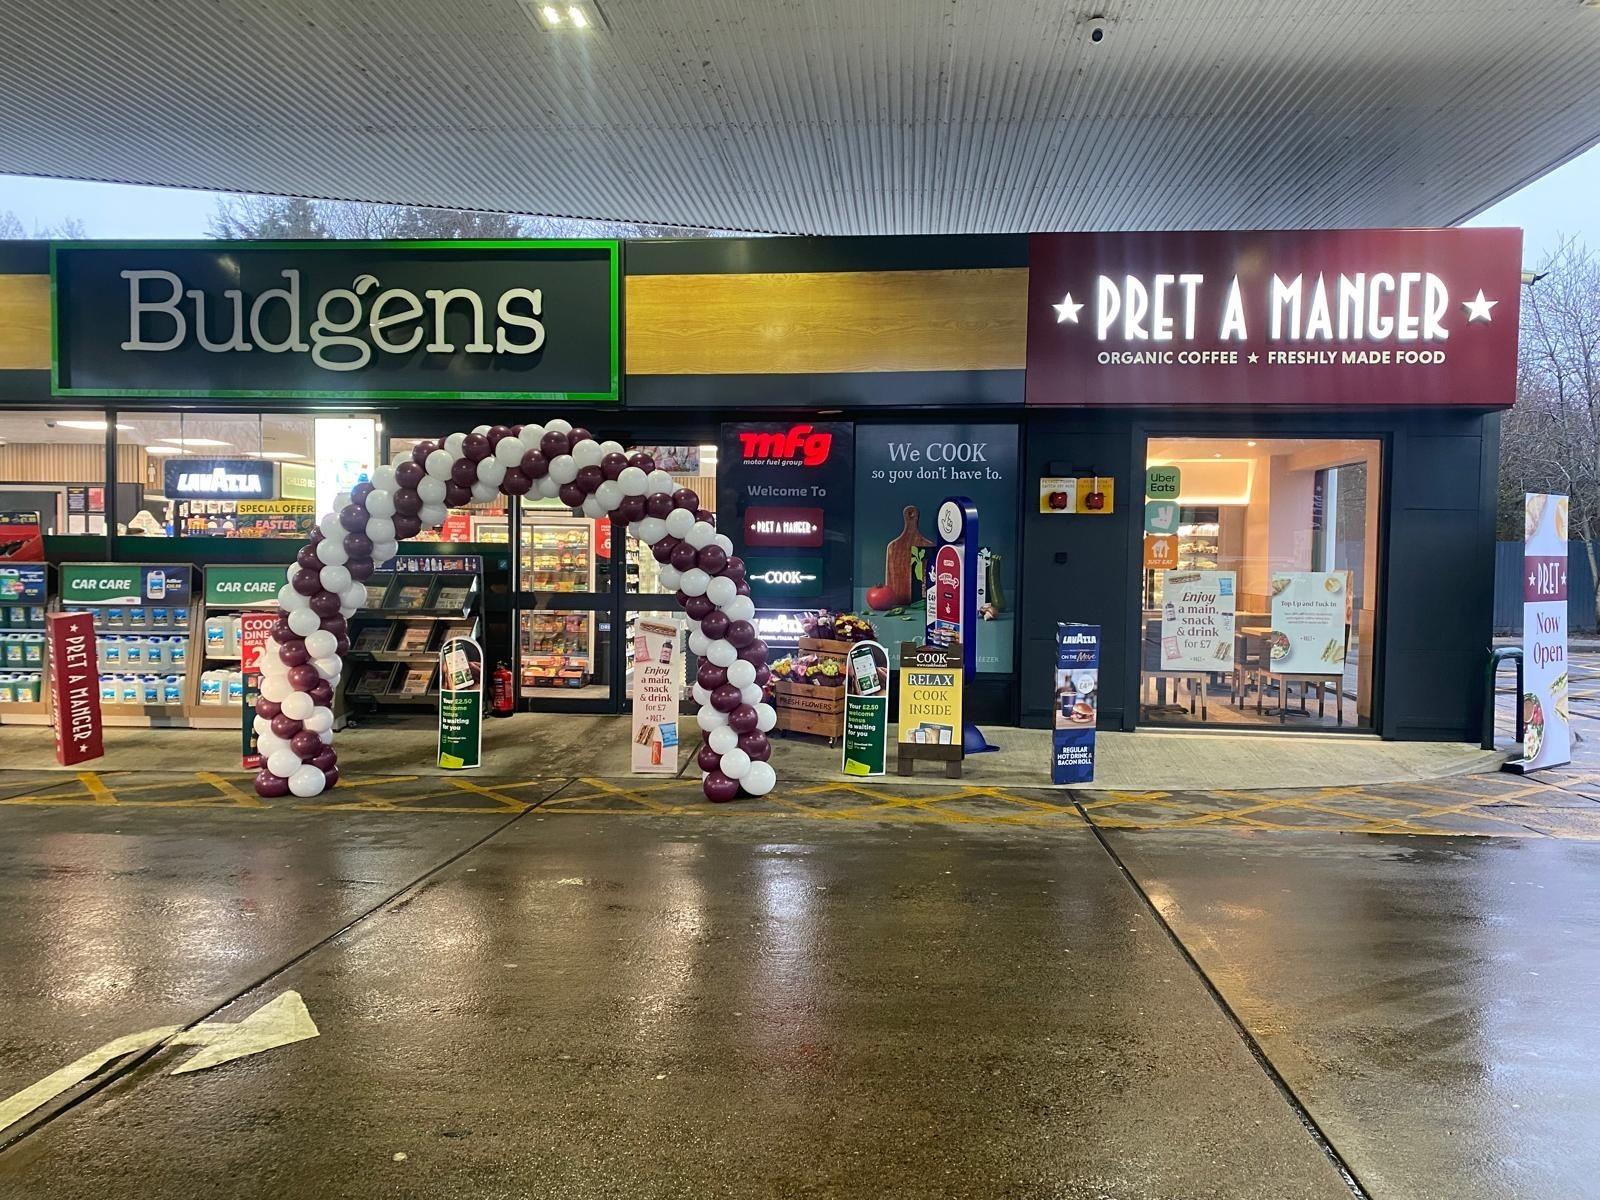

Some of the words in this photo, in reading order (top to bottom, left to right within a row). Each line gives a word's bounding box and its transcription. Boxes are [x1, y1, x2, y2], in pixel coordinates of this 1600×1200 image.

[1096, 273, 1203, 340] PRET
[1220, 274, 1247, 340] A
[1270, 271, 1450, 340] MANGER
[120, 269, 545, 371] Budgens
[1097, 351, 1173, 365] ORGANIC
[1178, 350, 1238, 364] COFFEE
[1268, 350, 1338, 365] FRESHLY
[1341, 350, 1391, 364] MADE
[1396, 350, 1446, 364] FOOD
[739, 424, 833, 466] mfg
[888, 442, 920, 461] We
[926, 442, 988, 462] COOK
[871, 469, 884, 479] so
[889, 470, 913, 483] you
[917, 466, 947, 479] don't
[951, 466, 982, 480] have
[986, 466, 1002, 480] to.
[1150, 473, 1176, 483] Uber
[747, 485, 807, 497] Welcome
[811, 486, 827, 497] To
[1150, 483, 1176, 493] Eats
[240, 505, 281, 513] SPECIAL
[282, 505, 314, 513] OFFER
[256, 520, 297, 530] EASTER
[756, 520, 775, 533] PRET
[775, 521, 782, 533] A
[782, 521, 812, 534] MANGER
[764, 571, 802, 584] COOK
[1537, 562, 1560, 595] PRET
[71, 579, 97, 590] CAR
[98, 579, 131, 590] CARE
[216, 582, 242, 593] CAR
[243, 582, 276, 593] CARE
[1182, 591, 1216, 605] Enjoy
[1178, 606, 1185, 614] a
[1182, 615, 1215, 626] snack
[1536, 612, 1561, 635] Now
[244, 631, 271, 640] DINE
[1177, 627, 1185, 636] &
[1187, 626, 1219, 637] drink
[1063, 633, 1096, 644] LAVAZZA
[1184, 639, 1198, 648] for
[1200, 639, 1211, 649] £7
[65, 636, 88, 668] PRET
[1533, 643, 1564, 669] Open
[916, 653, 948, 664] COOK
[644, 666, 670, 677] Enjoy
[69, 675, 87, 684] A
[909, 674, 953, 686] RELAX
[643, 685, 669, 693] snack
[640, 694, 648, 702] &
[648, 694, 672, 702] drink
[913, 690, 948, 701] COOK
[645, 703, 656, 711] for
[780, 696, 800, 706] FRESH
[801, 700, 832, 711] FLOWERS
[69, 688, 92, 742] MANGER
[909, 703, 952, 716] INSIDE
